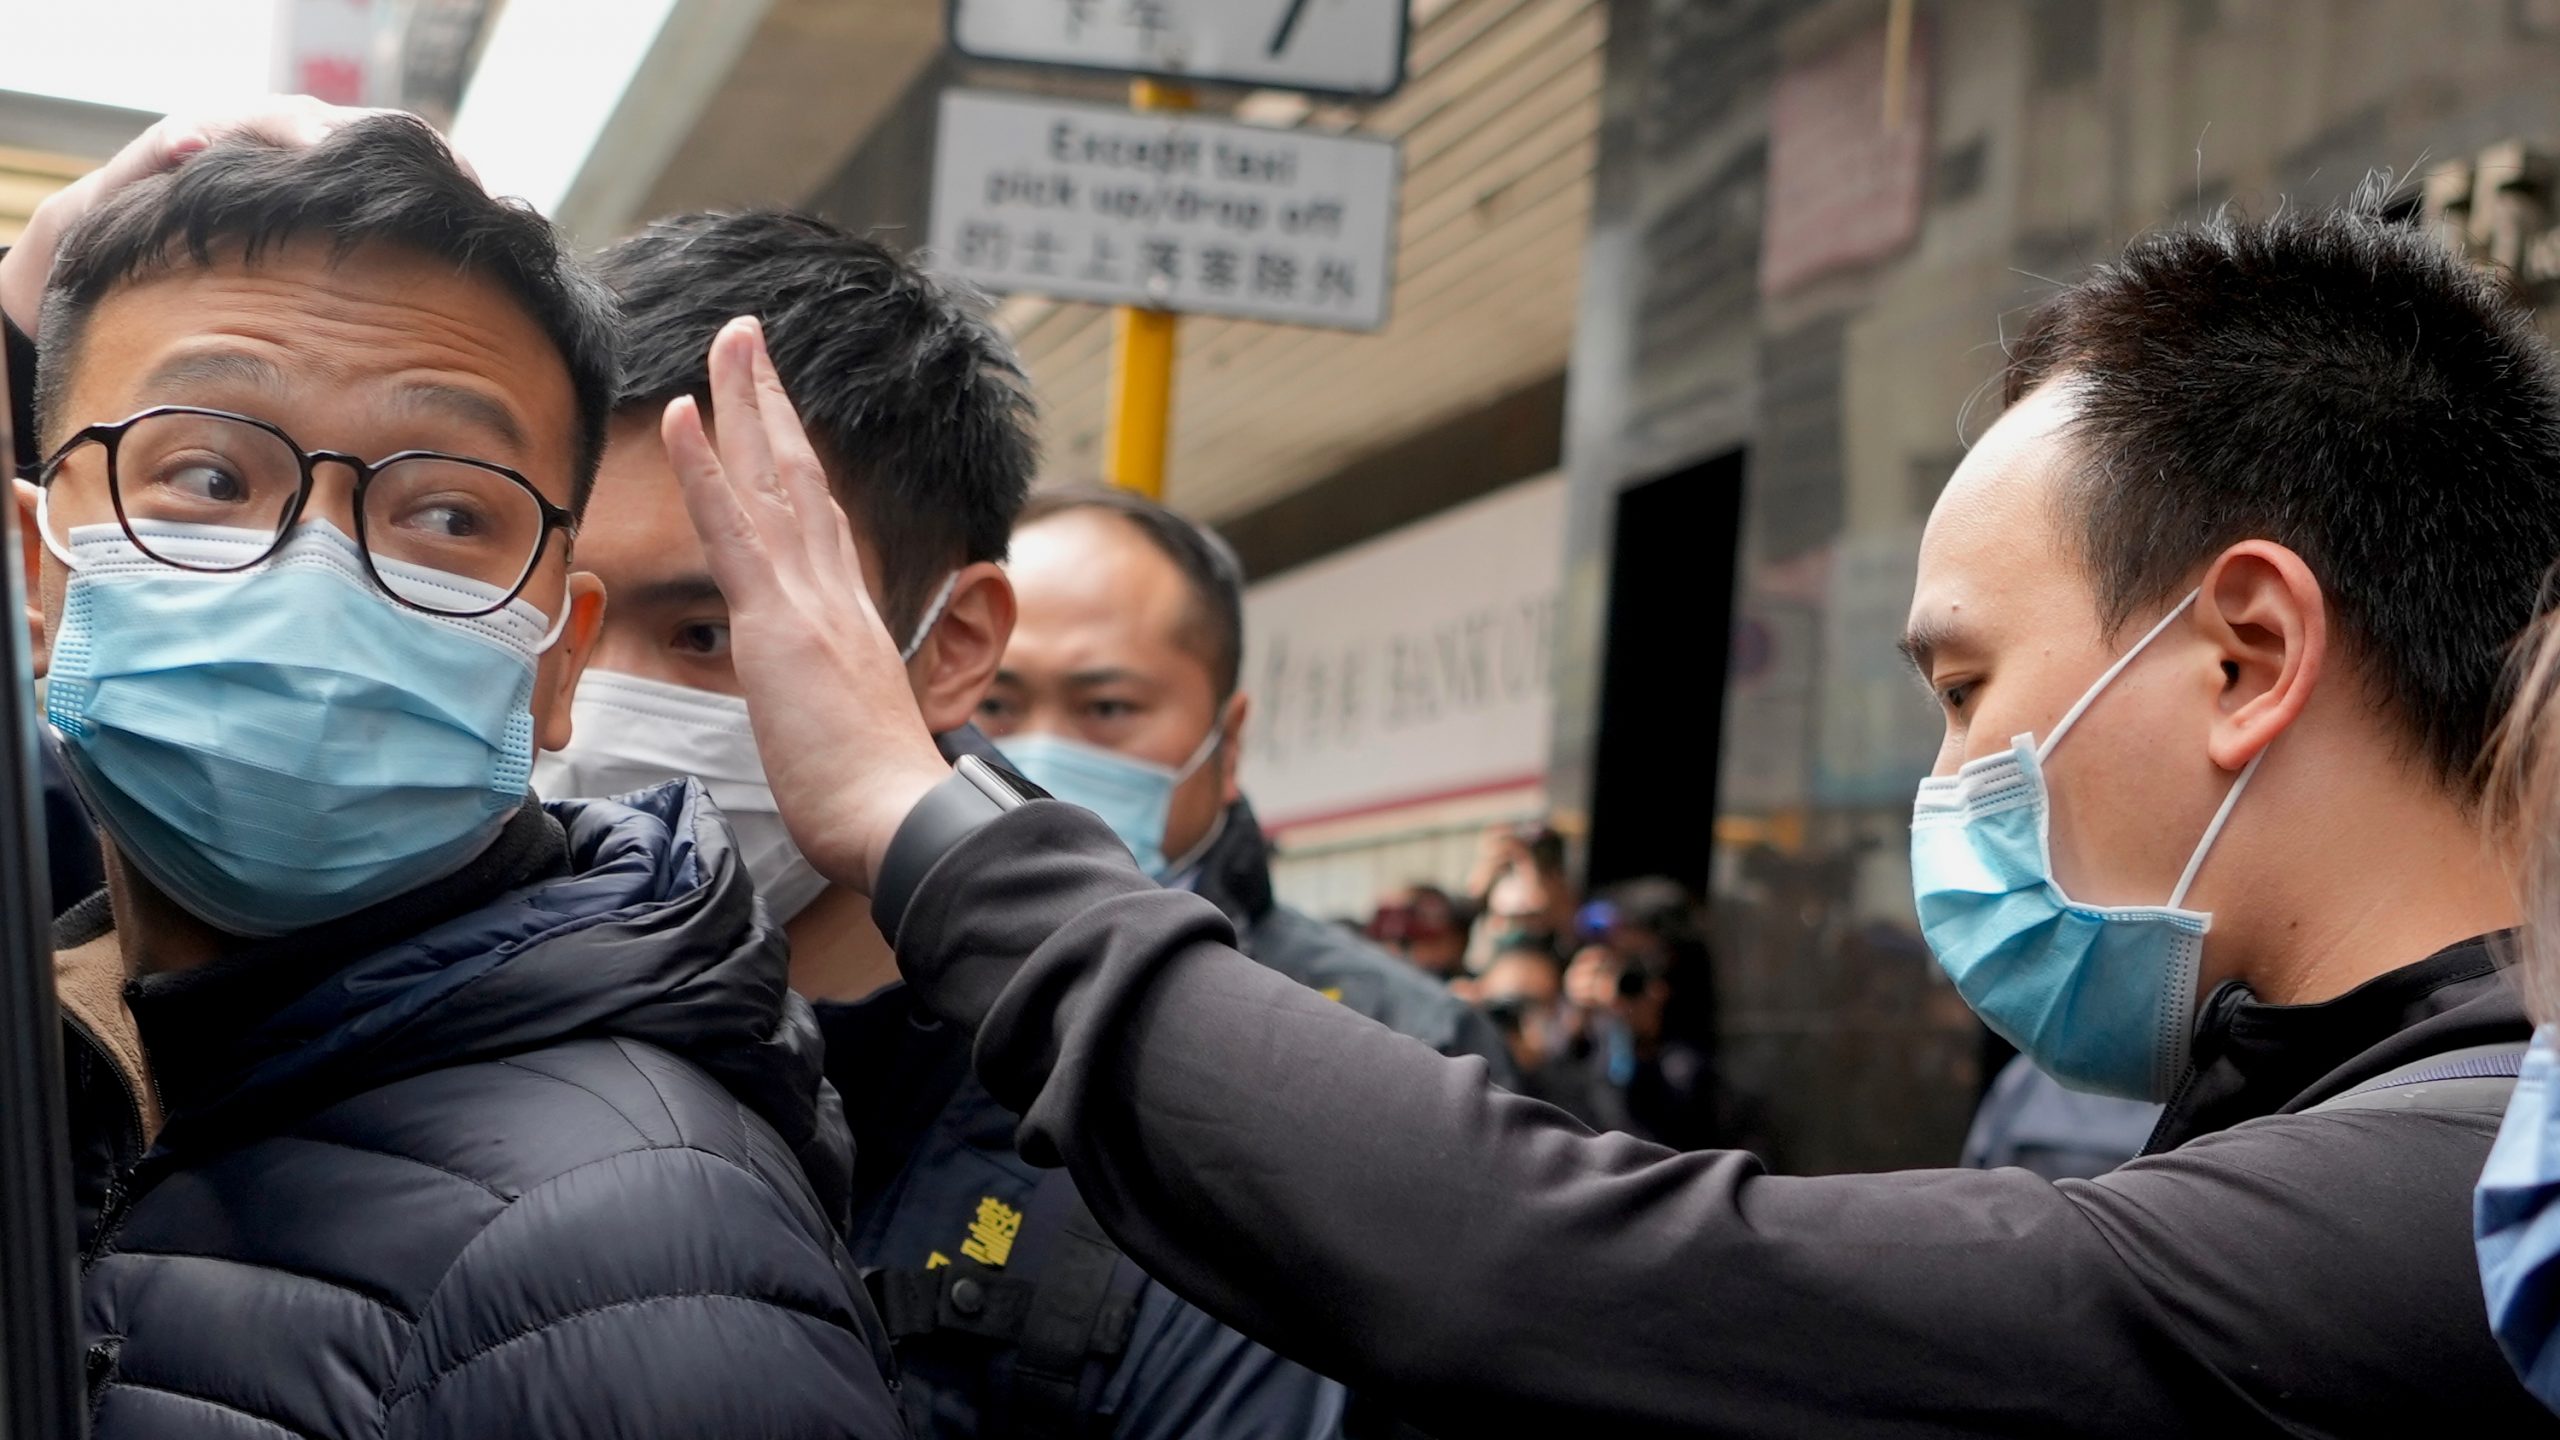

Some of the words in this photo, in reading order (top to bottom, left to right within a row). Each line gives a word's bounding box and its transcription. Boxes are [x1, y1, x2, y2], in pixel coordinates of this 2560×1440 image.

[1050, 119, 1200, 174] Except
[1215, 143, 1297, 184] taxi
[987, 170, 1077, 208] pick
[1092, 186, 1268, 233] up/drop
[1279, 200, 1344, 238] off
